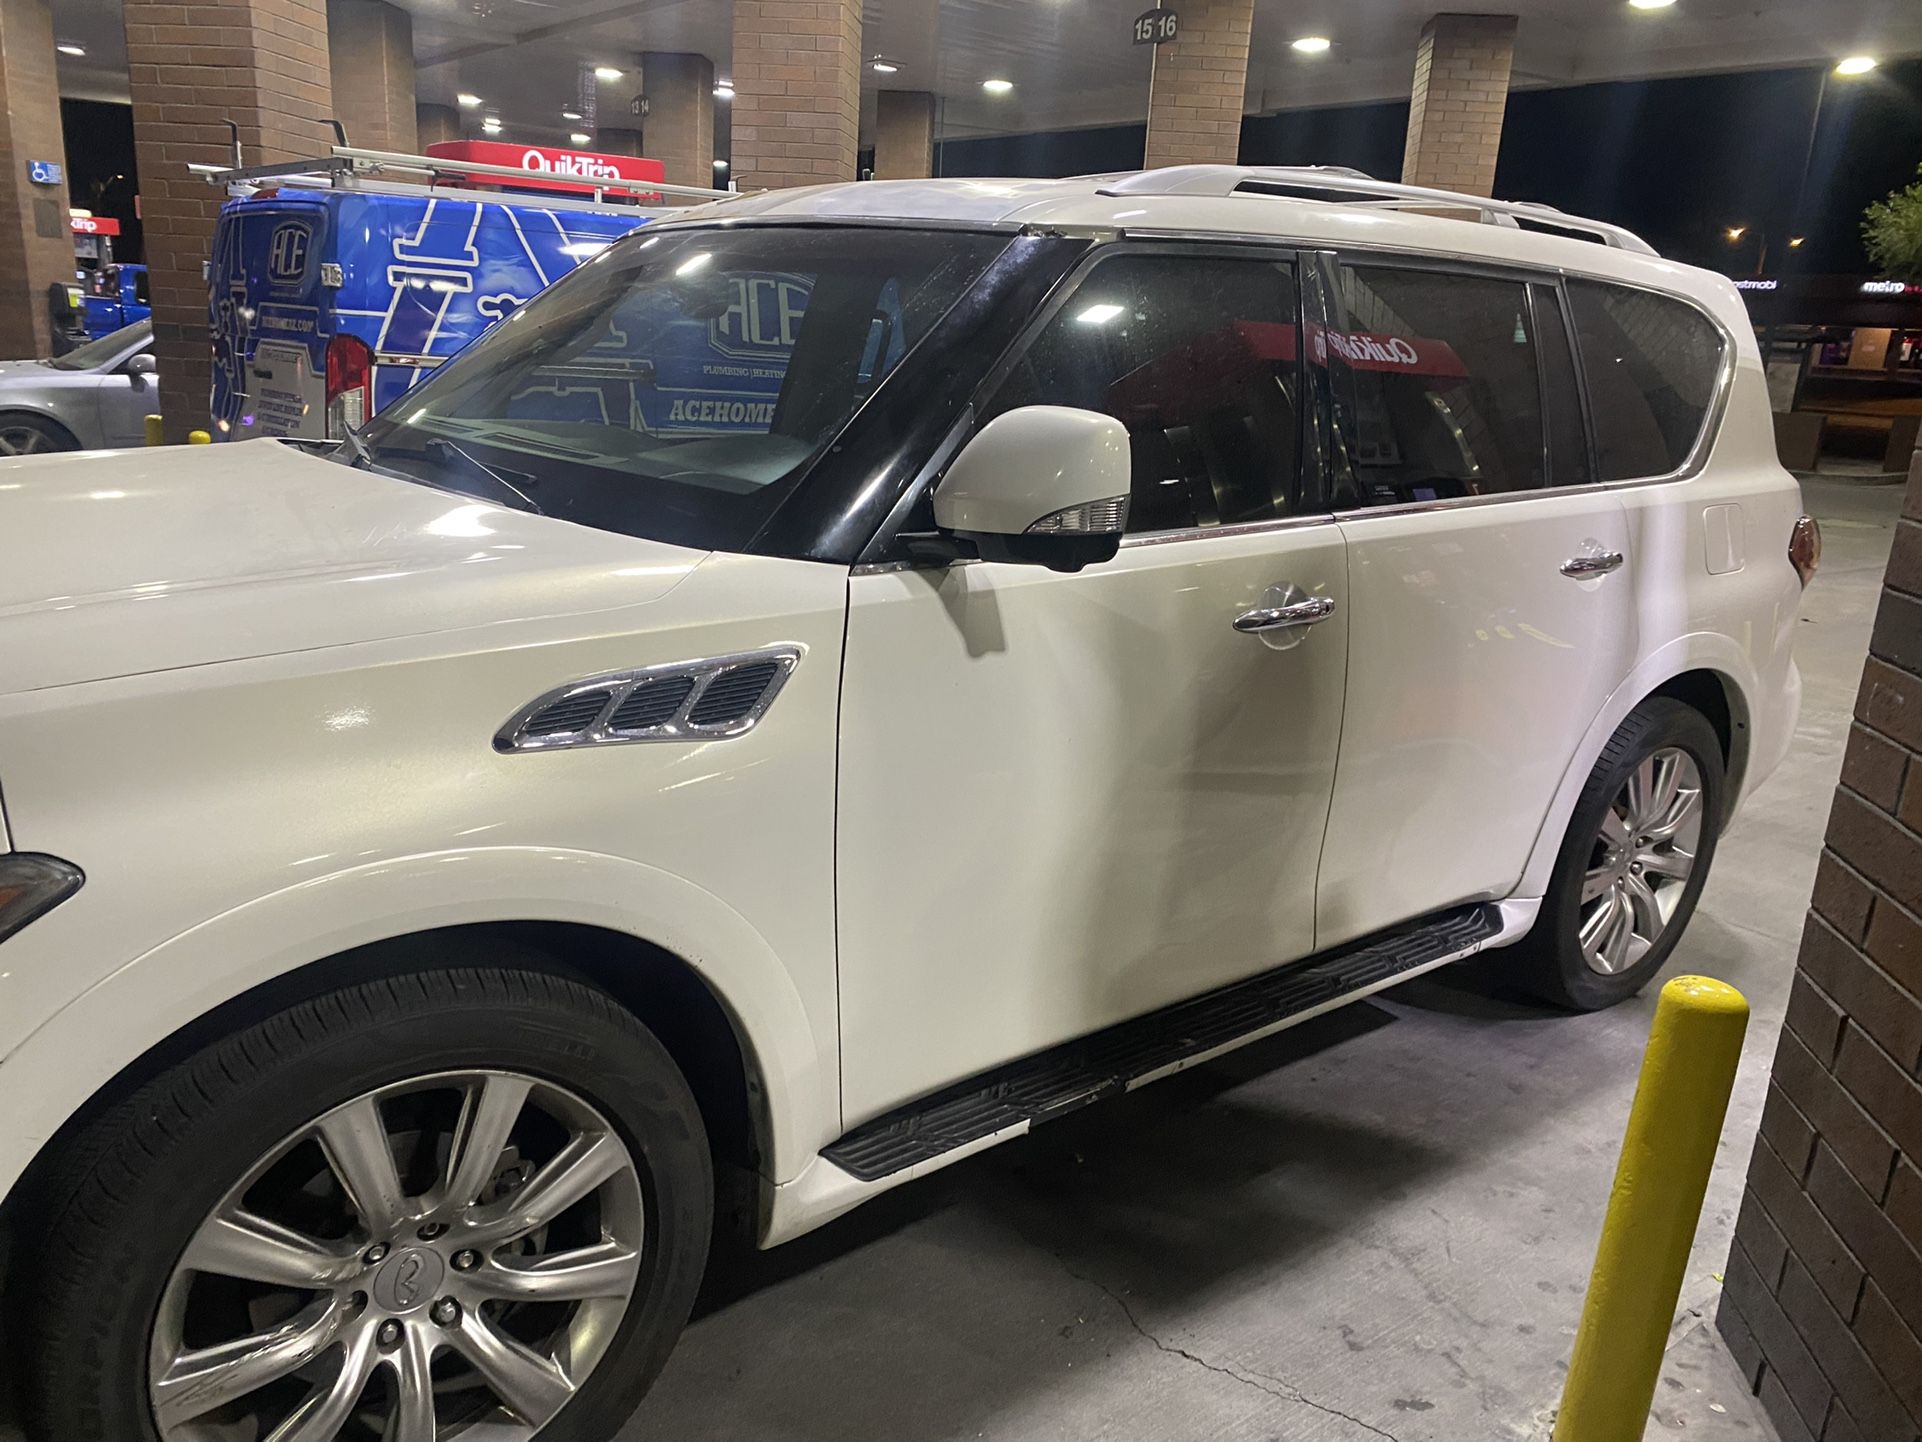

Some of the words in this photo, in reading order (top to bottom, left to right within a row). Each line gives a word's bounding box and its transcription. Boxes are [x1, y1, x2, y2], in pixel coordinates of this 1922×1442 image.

[1135, 18, 1153, 40] 15
[1158, 14, 1177, 37] 16
[522, 149, 621, 191] QuikTrip
[270, 228, 308, 276] ACE
[1863, 280, 1905, 293] metro
[718, 277, 809, 346] ACE
[703, 365, 750, 377] PLUMBING
